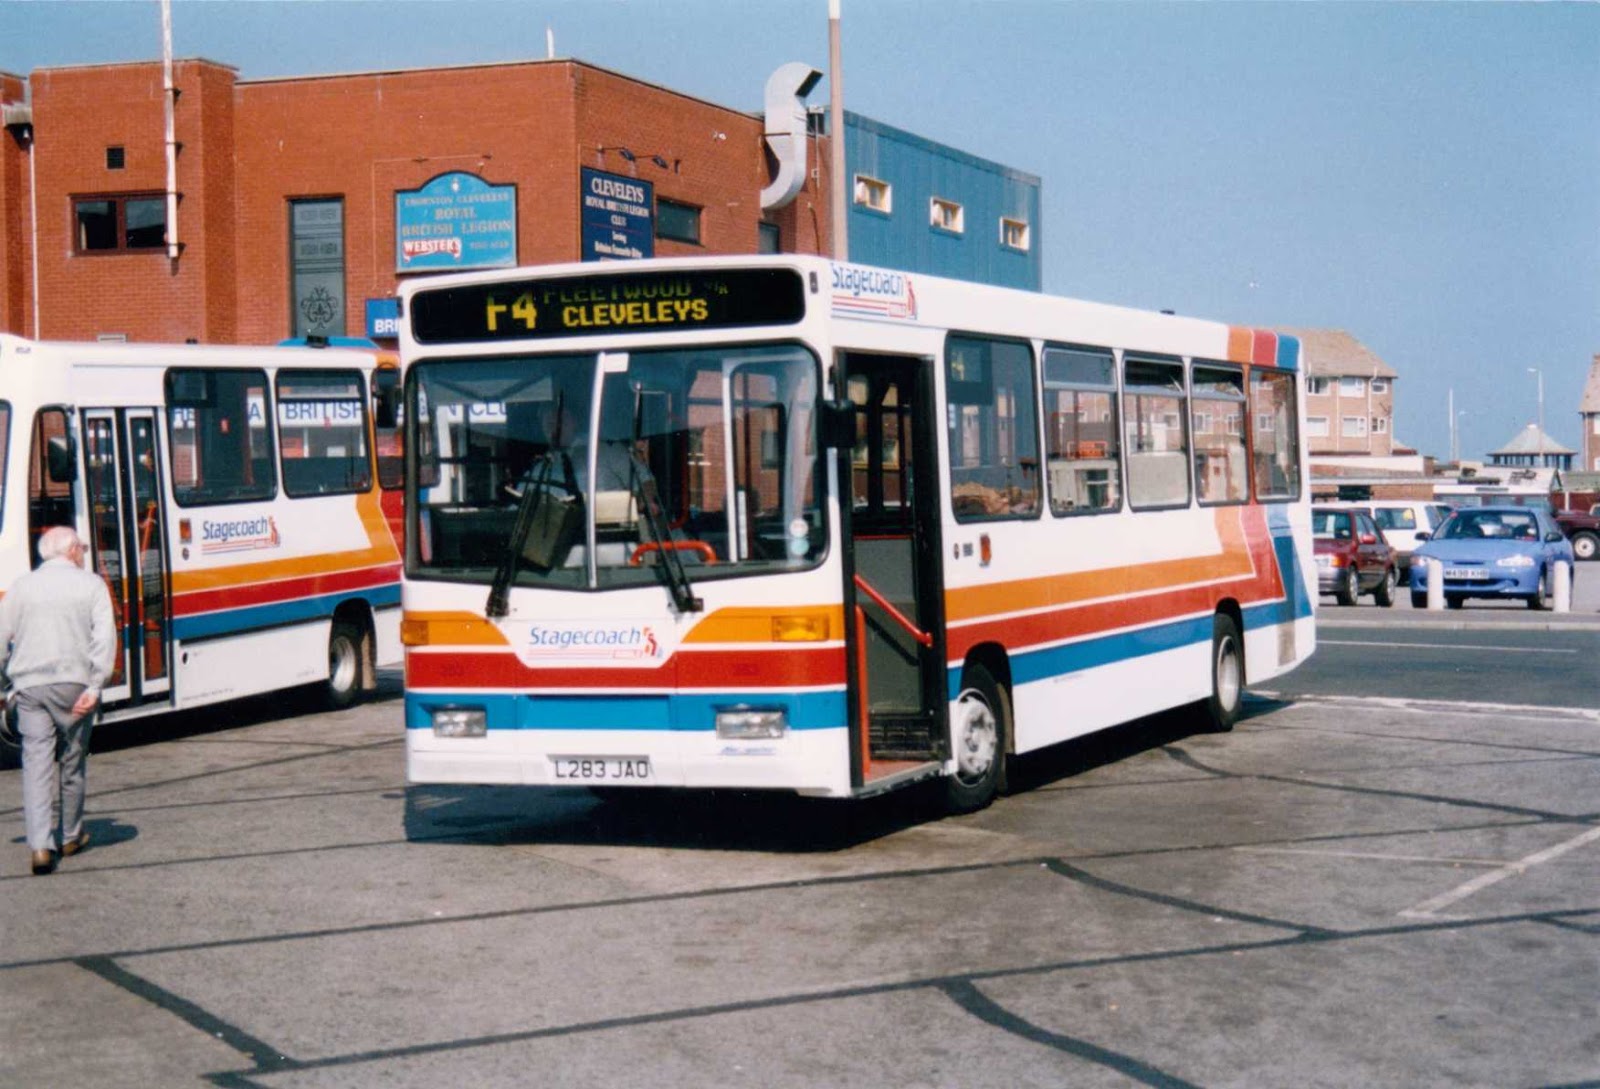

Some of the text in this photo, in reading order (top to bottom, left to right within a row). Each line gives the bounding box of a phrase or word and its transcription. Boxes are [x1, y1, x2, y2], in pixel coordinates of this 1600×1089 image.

[591, 177, 644, 203] CLEVELEYS
[563, 299, 708, 328] CLEVELEYS
[202, 516, 268, 542] Stagecoach
[529, 627, 641, 648] Stagecoach
[555, 760, 606, 778] L283
